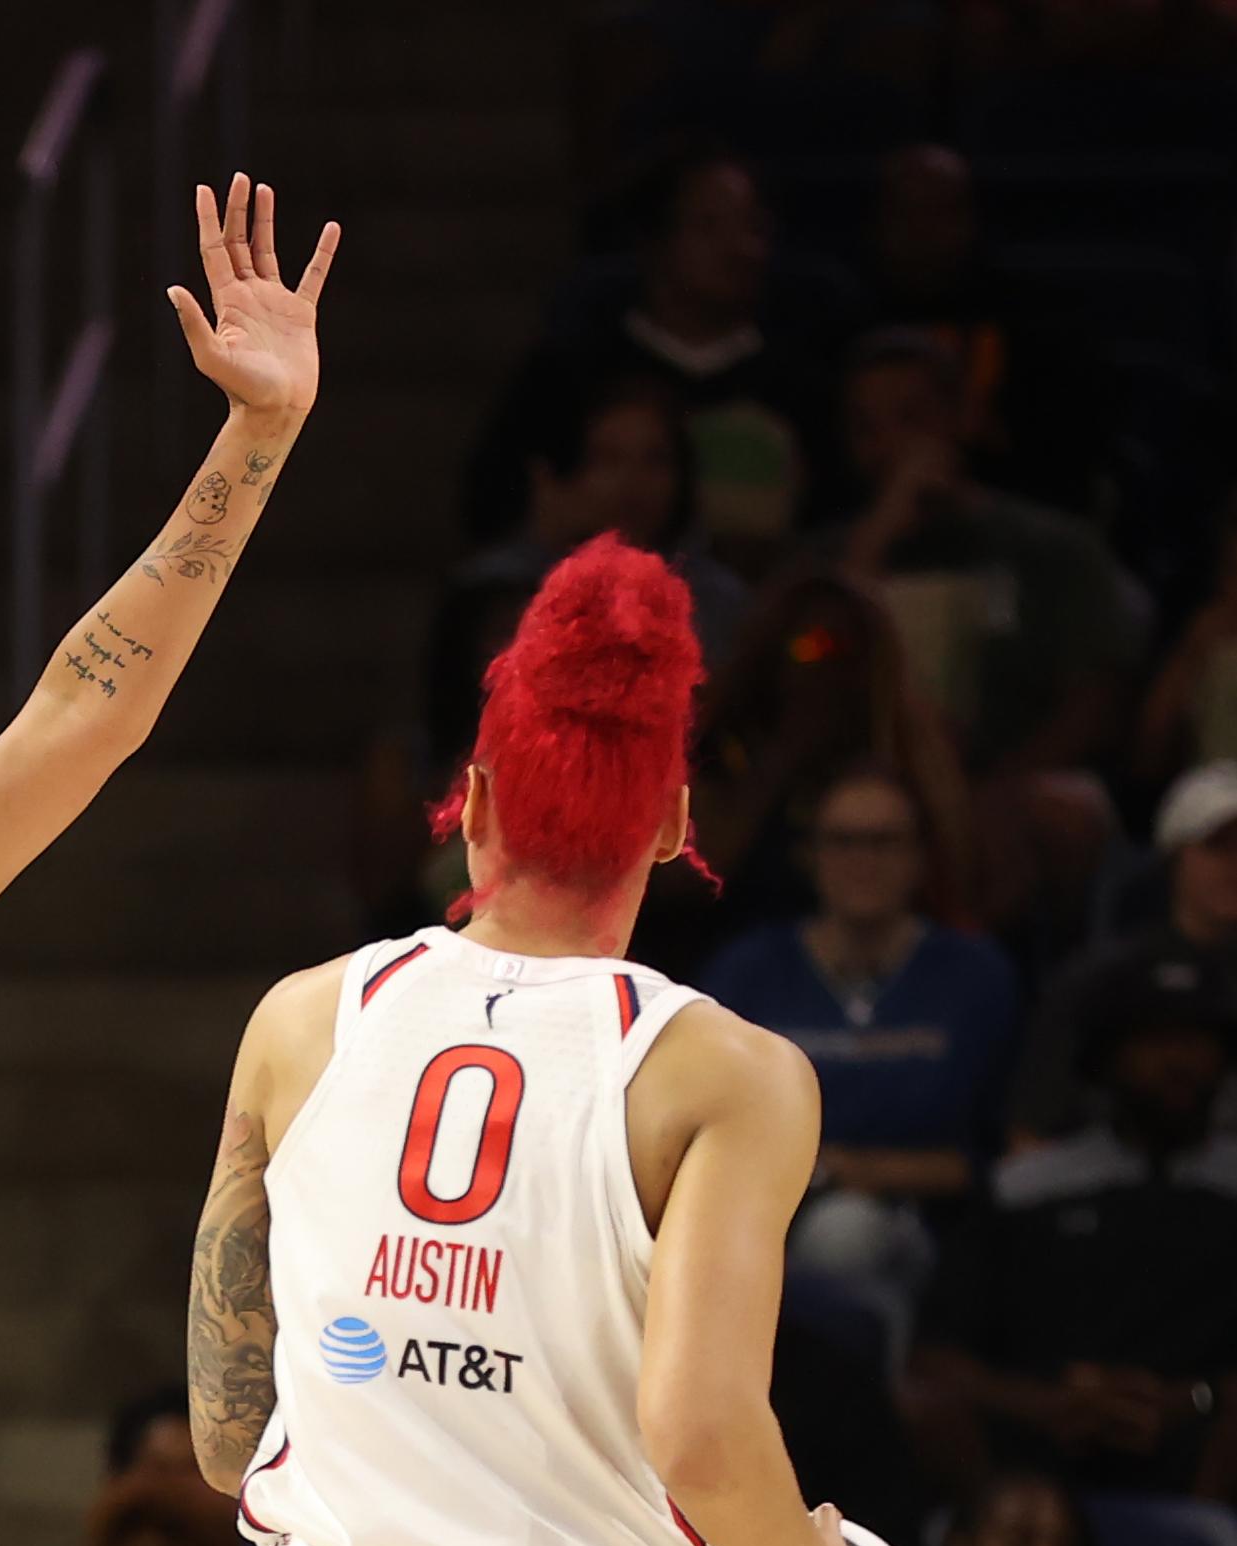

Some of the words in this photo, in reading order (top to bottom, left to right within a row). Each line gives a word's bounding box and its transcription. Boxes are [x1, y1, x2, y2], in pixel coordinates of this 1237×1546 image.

[397, 1043, 526, 1226] 0
[364, 1233, 504, 1314] AUSTIN
[397, 1338, 524, 1394] AT&T
